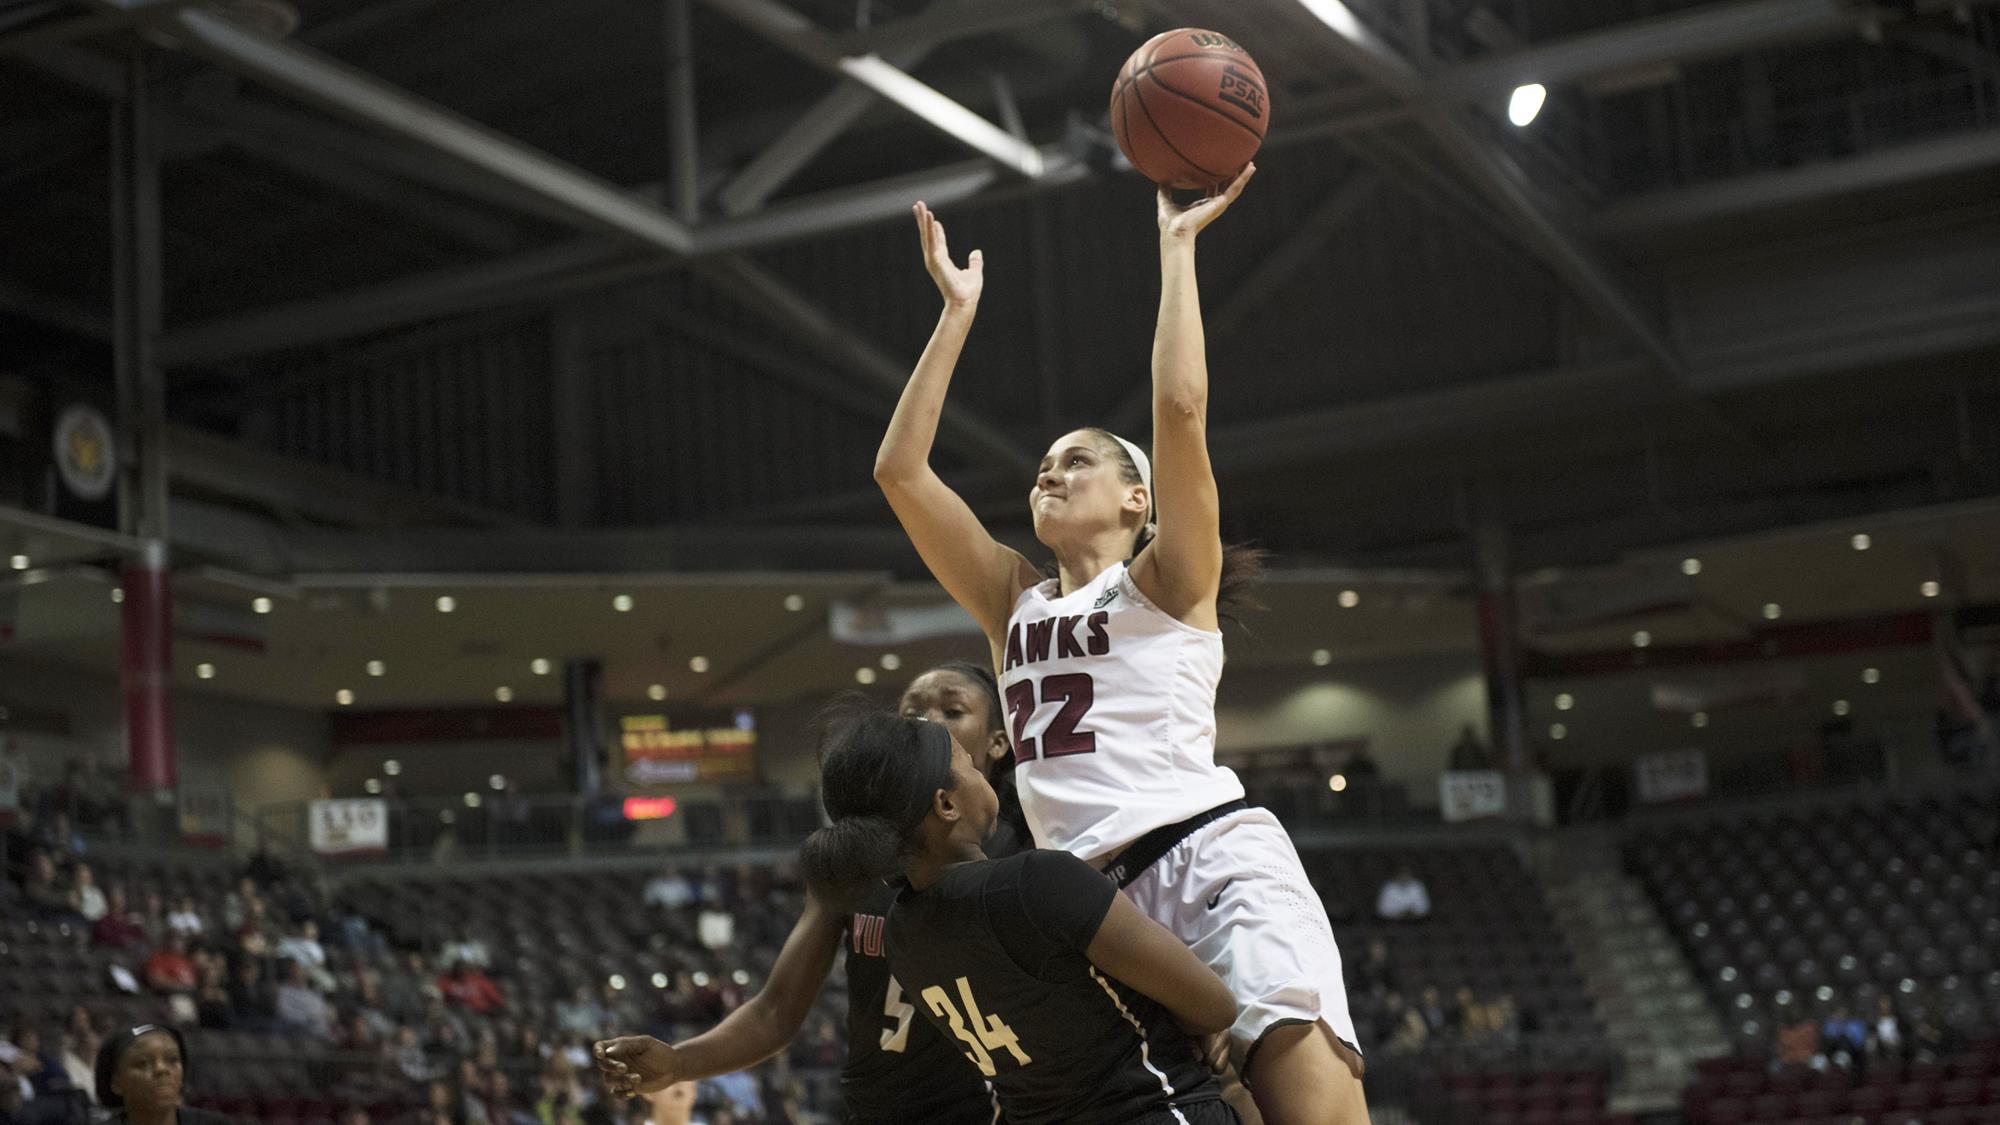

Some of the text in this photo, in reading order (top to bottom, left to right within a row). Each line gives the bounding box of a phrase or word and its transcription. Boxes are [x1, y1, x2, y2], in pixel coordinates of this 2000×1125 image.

[1220, 74, 1265, 113] PSAC
[1005, 611, 1110, 672] AWKS
[1005, 672, 1096, 765] 22
[880, 973, 915, 1053] 5
[921, 976, 1032, 1077] 34
